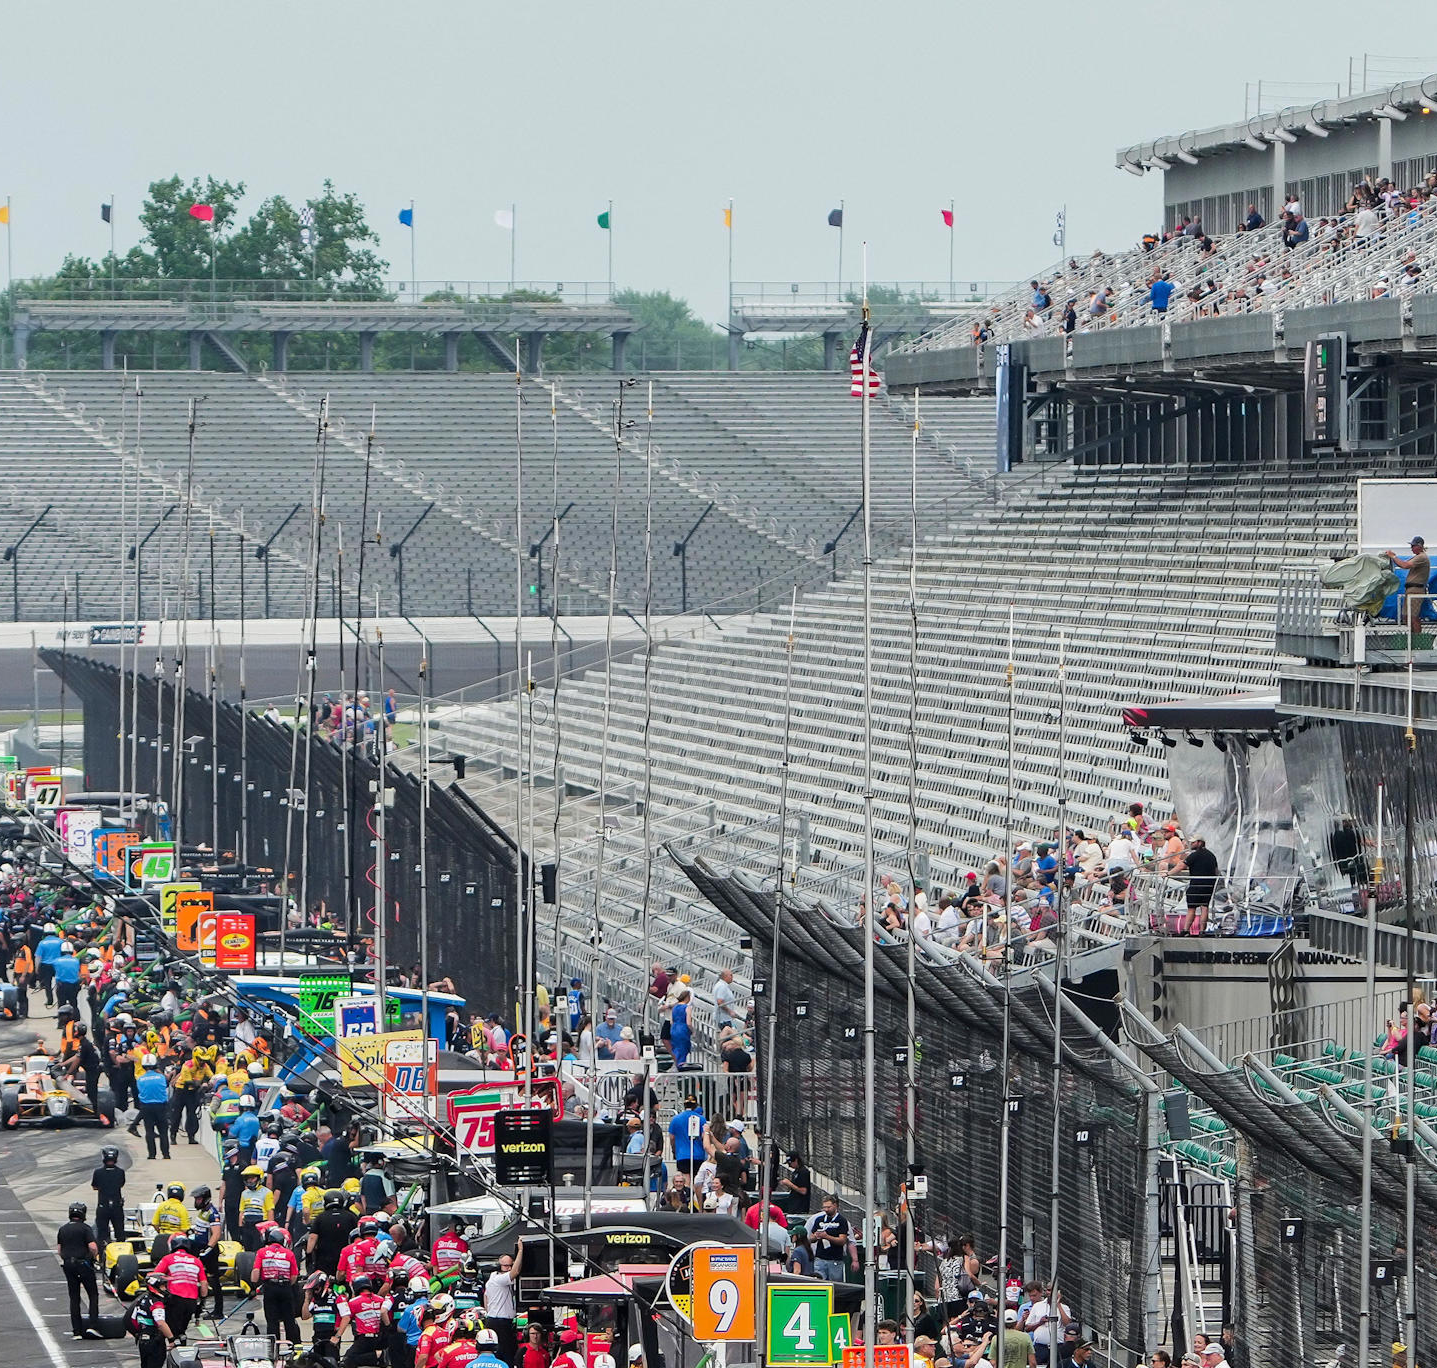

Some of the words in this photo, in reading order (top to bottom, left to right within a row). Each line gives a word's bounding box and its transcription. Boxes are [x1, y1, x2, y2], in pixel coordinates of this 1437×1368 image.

[36, 787, 58, 805] 47
[144, 856, 171, 878] 45
[312, 991, 339, 1010] 76
[462, 1116, 496, 1149] 75
[501, 1141, 546, 1154] verizon
[606, 1232, 652, 1245] verizon
[1286, 1225, 1296, 1237] 9
[1376, 1266, 1386, 1279] 8
[708, 1279, 739, 1333] 9
[782, 1301, 816, 1350] 4
[834, 1327, 847, 1349] 4
[473, 1361, 503, 1368] OFFICIAL
